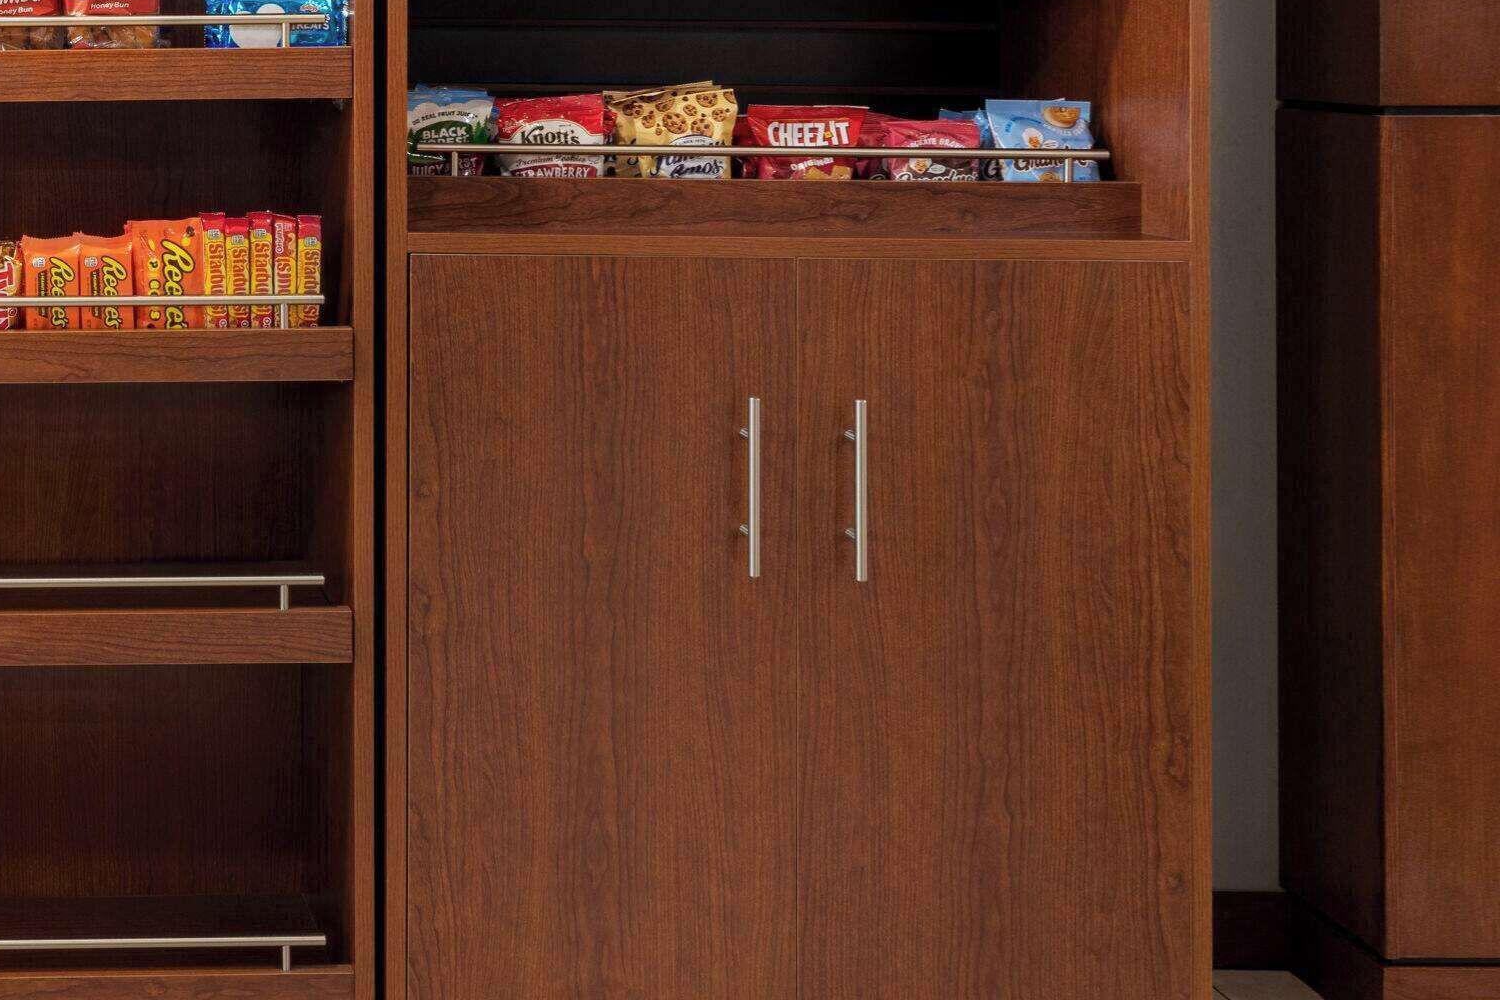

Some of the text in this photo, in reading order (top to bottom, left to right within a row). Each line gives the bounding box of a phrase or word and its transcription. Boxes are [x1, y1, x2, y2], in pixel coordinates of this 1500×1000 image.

[422, 127, 467, 139] BLACK
[521, 125, 580, 144] Knott's
[767, 120, 850, 146] CHEEZ-IT
[275, 223, 283, 253] Original
